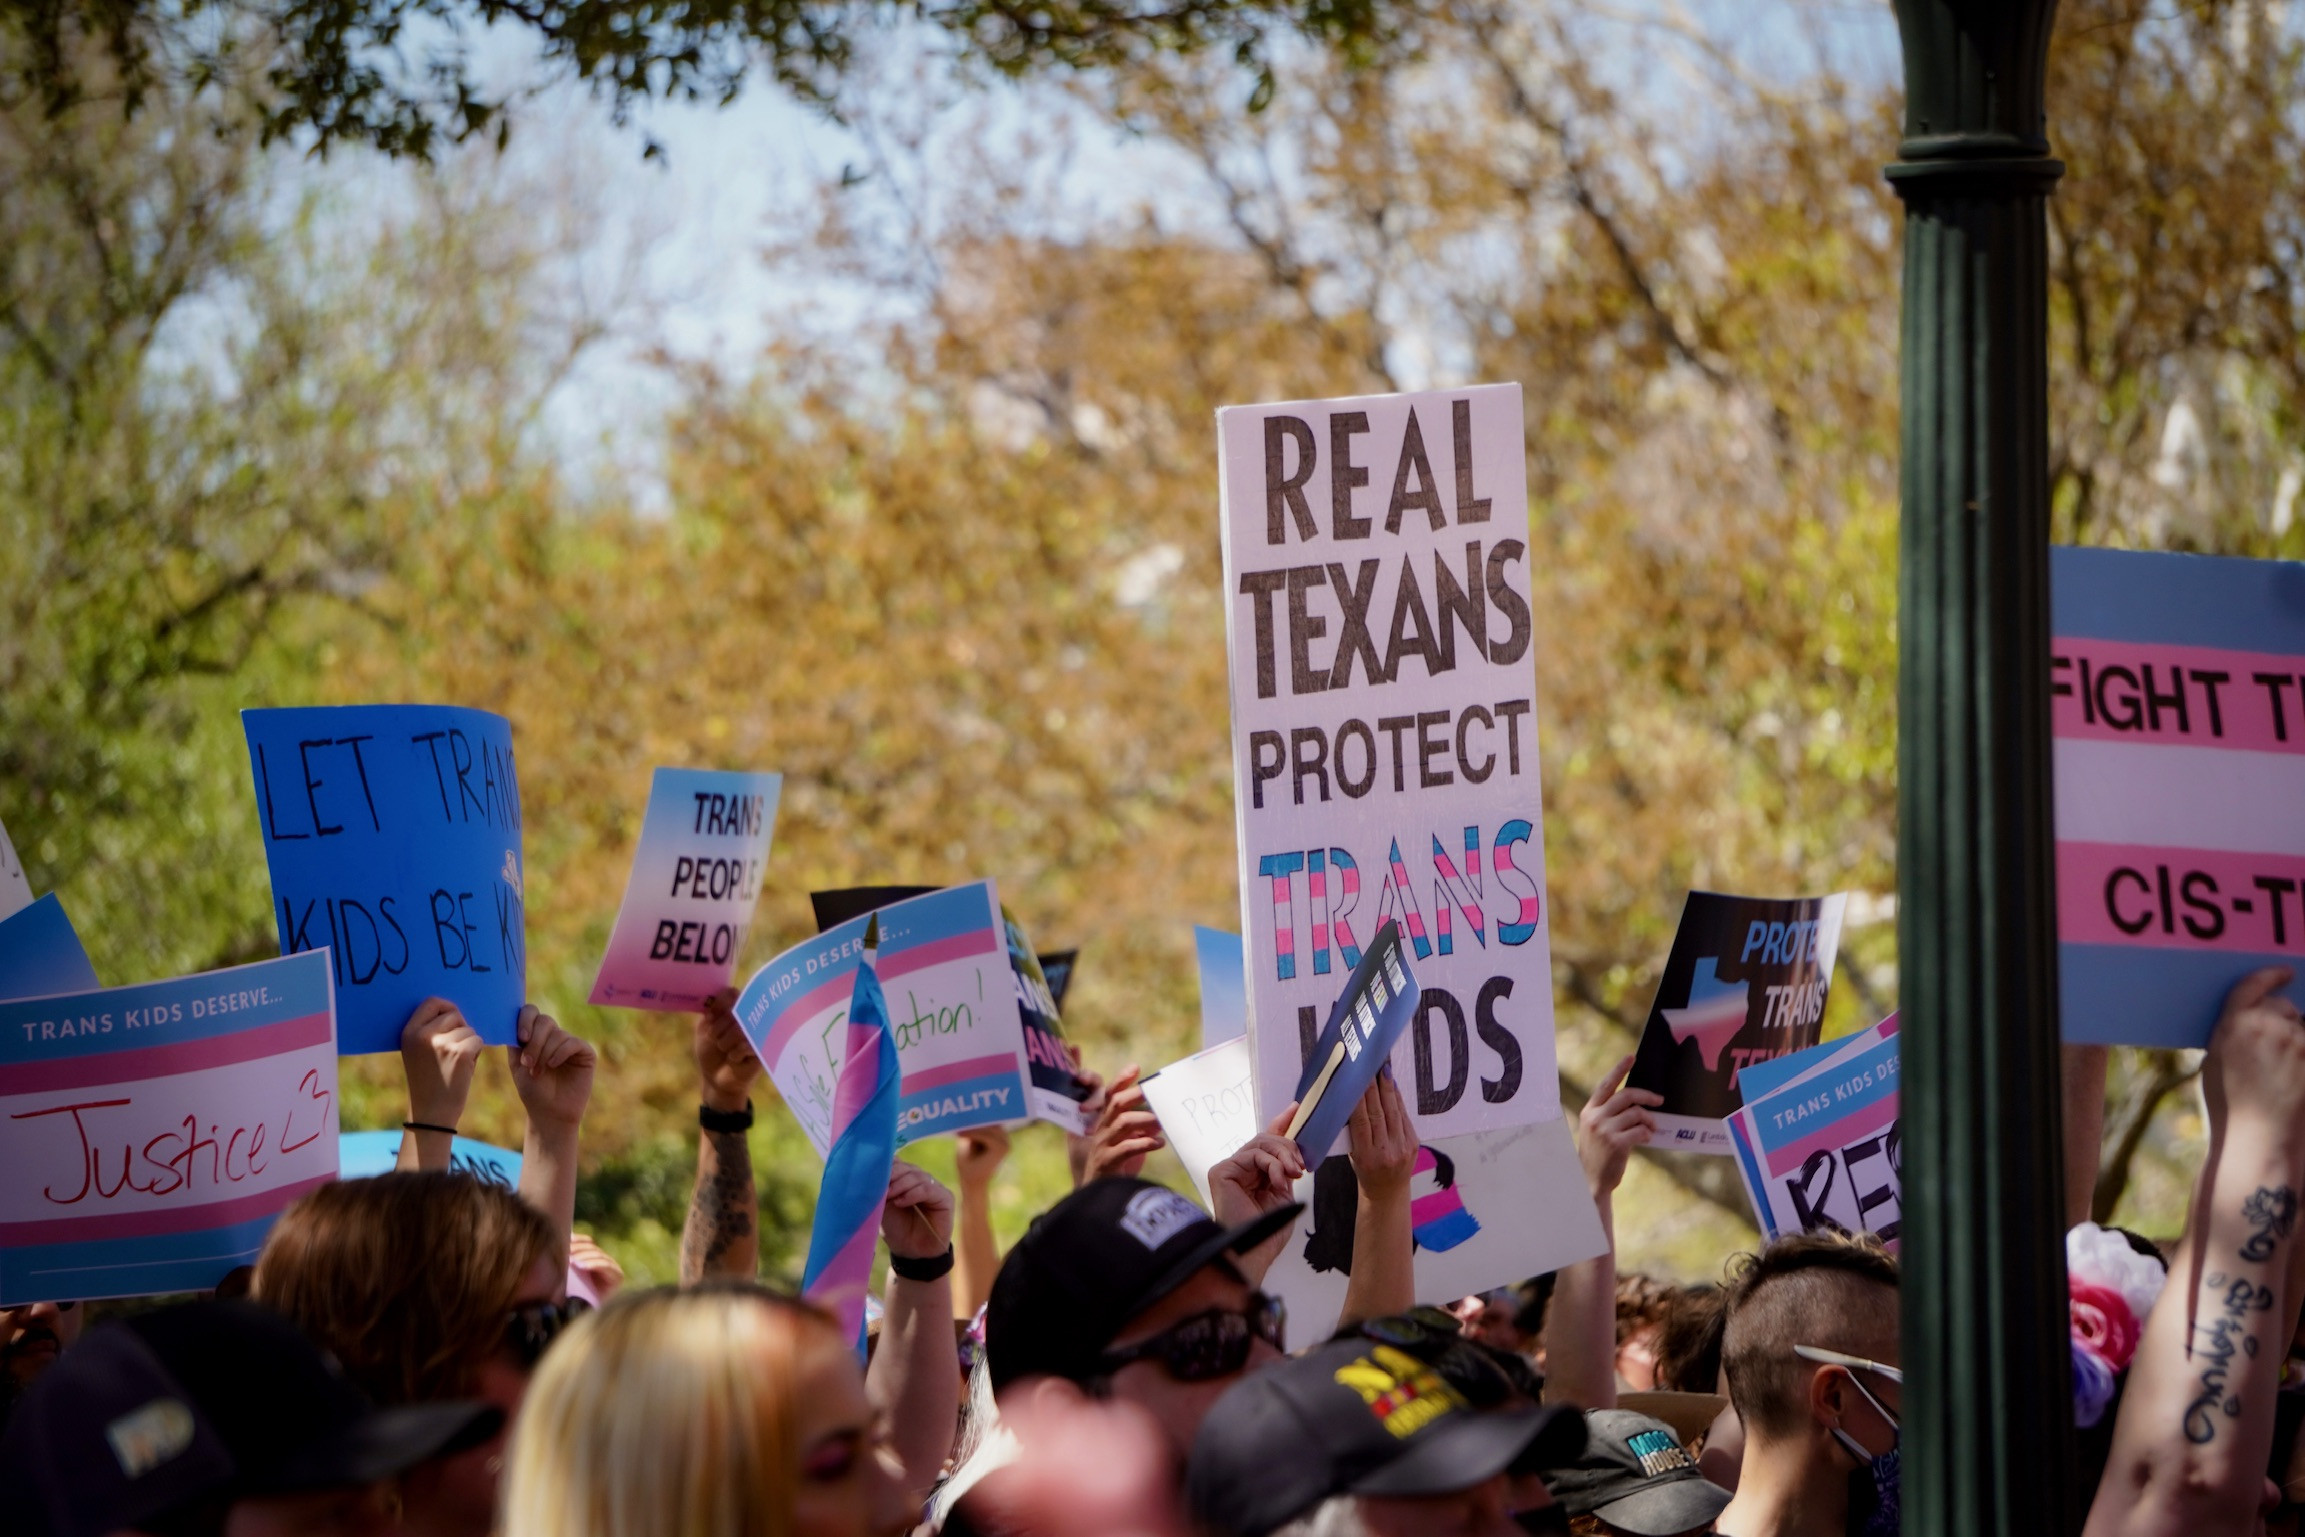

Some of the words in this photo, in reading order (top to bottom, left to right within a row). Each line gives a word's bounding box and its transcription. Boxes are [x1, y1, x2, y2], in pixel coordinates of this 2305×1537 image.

[1264, 399, 1493, 545] REAL
[1239, 538, 1532, 699] TEXANS
[1249, 699, 1531, 809] PROTECT
[258, 735, 380, 840] LET
[694, 792, 764, 836] TRANS
[1259, 819, 1540, 981] TRANS
[283, 896, 409, 987] KIDS
[430, 888, 491, 972] BE
[650, 919, 743, 967] BELO
[1740, 920, 1821, 966] PROTE
[748, 993, 770, 1031] TRANS
[769, 967, 801, 1002] KIDS
[805, 926, 911, 975] DESERE...
[1762, 982, 1828, 1028] TRANS
[22, 1013, 114, 1042] TRANS
[125, 1003, 183, 1029] KIDS
[192, 986, 284, 1017] DESERVE...
[897, 1087, 1011, 1132] EQUALITY
[1181, 1074, 1252, 1137] PROT
[1772, 1091, 1831, 1131] TRANS
[1835, 1070, 1873, 1101] KIDS
[11, 1098, 269, 1204] Justice
[1639, 1447, 1690, 1478] HOUSE
